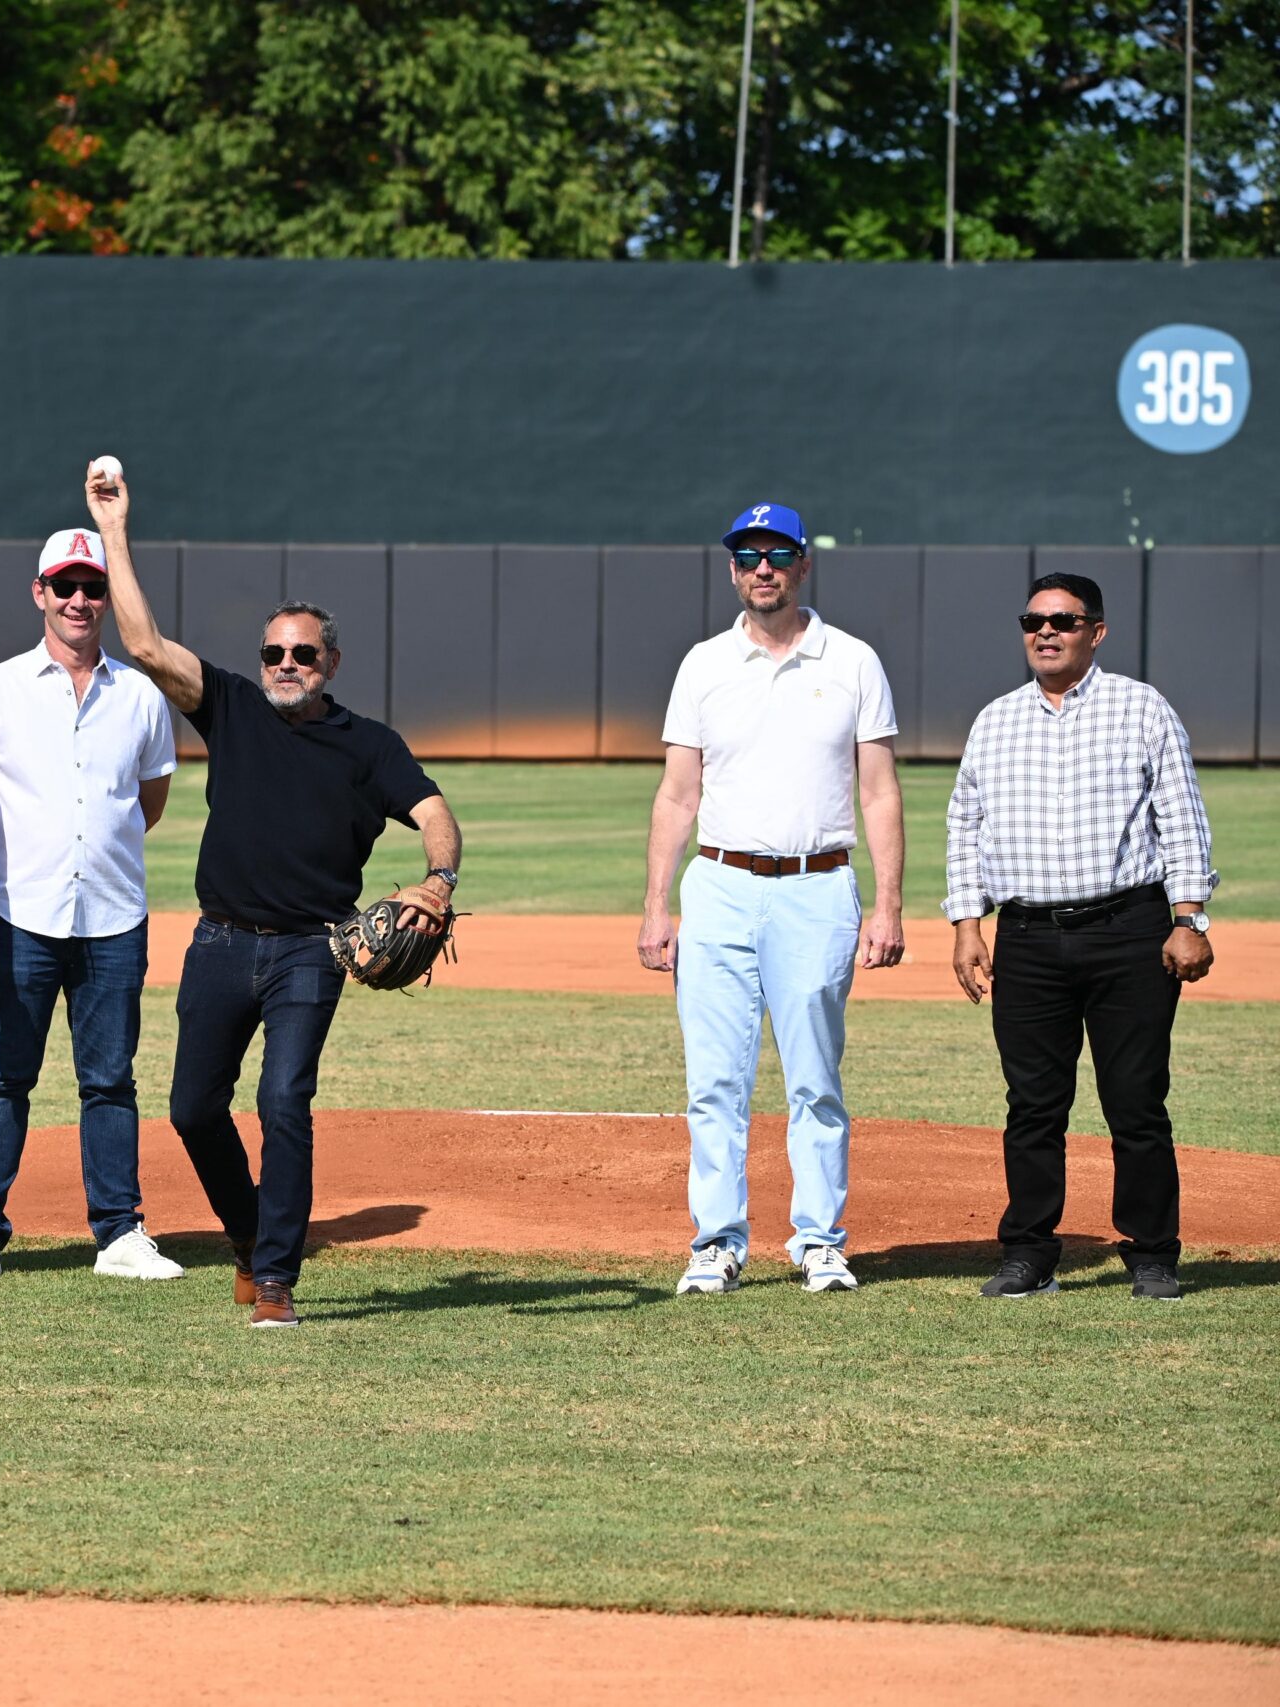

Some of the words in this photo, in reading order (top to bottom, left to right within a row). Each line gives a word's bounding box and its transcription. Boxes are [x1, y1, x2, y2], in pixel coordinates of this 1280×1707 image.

[1135, 350, 1235, 426] 385
[747, 505, 771, 528] L
[66, 533, 93, 558] A
